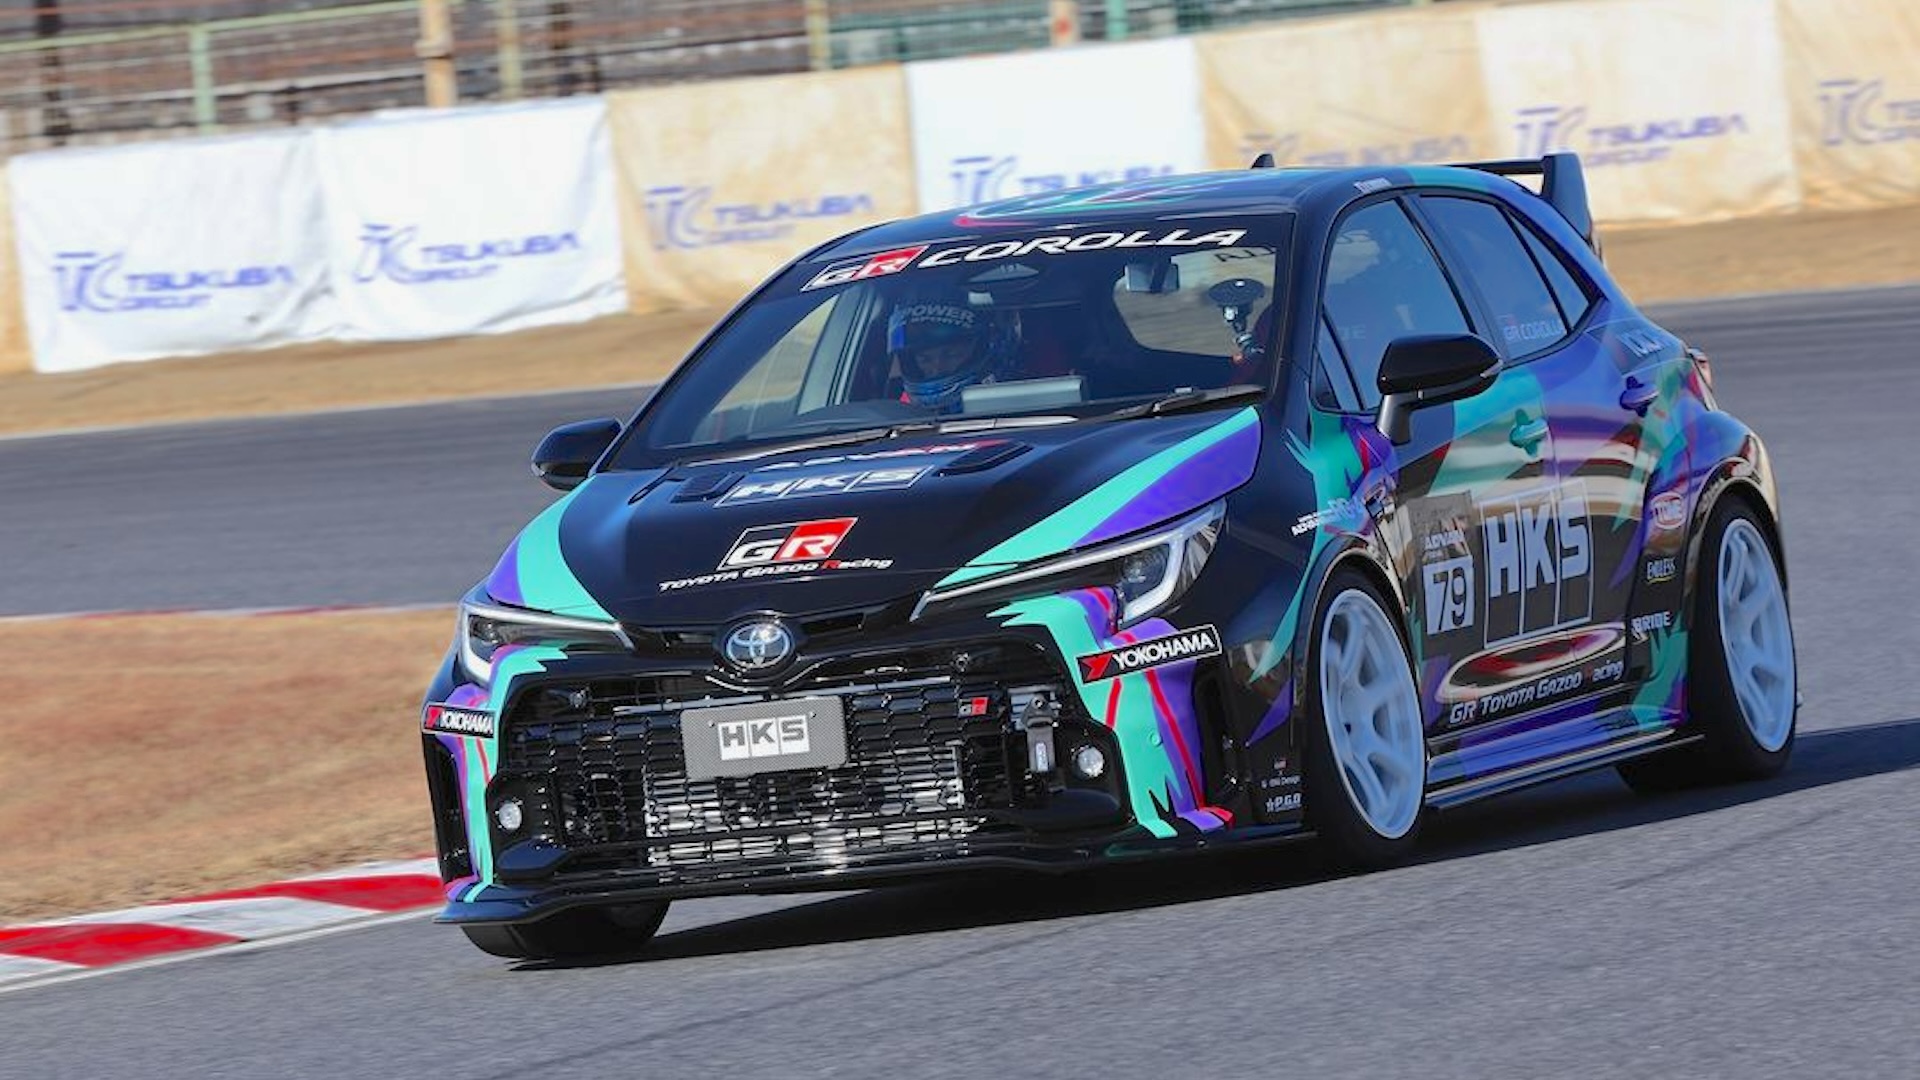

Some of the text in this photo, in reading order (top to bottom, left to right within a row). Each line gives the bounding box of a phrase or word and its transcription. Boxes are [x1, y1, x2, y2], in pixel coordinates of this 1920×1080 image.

[804, 251, 918, 290] GR
[917, 228, 1248, 270] COROLLA
[722, 526, 848, 567] GR
[1485, 496, 1590, 598] HKS
[658, 557, 894, 592] TOYOTA GAZOO Racing
[1432, 566, 1468, 632] 79
[1112, 632, 1215, 670] YOKOHAMA
[1449, 700, 1477, 724] GR
[1480, 685, 1536, 716] TOYOTA
[1536, 671, 1582, 699] GAZOO
[440, 710, 494, 735] YOKOHAMA
[721, 714, 804, 748] HKS
